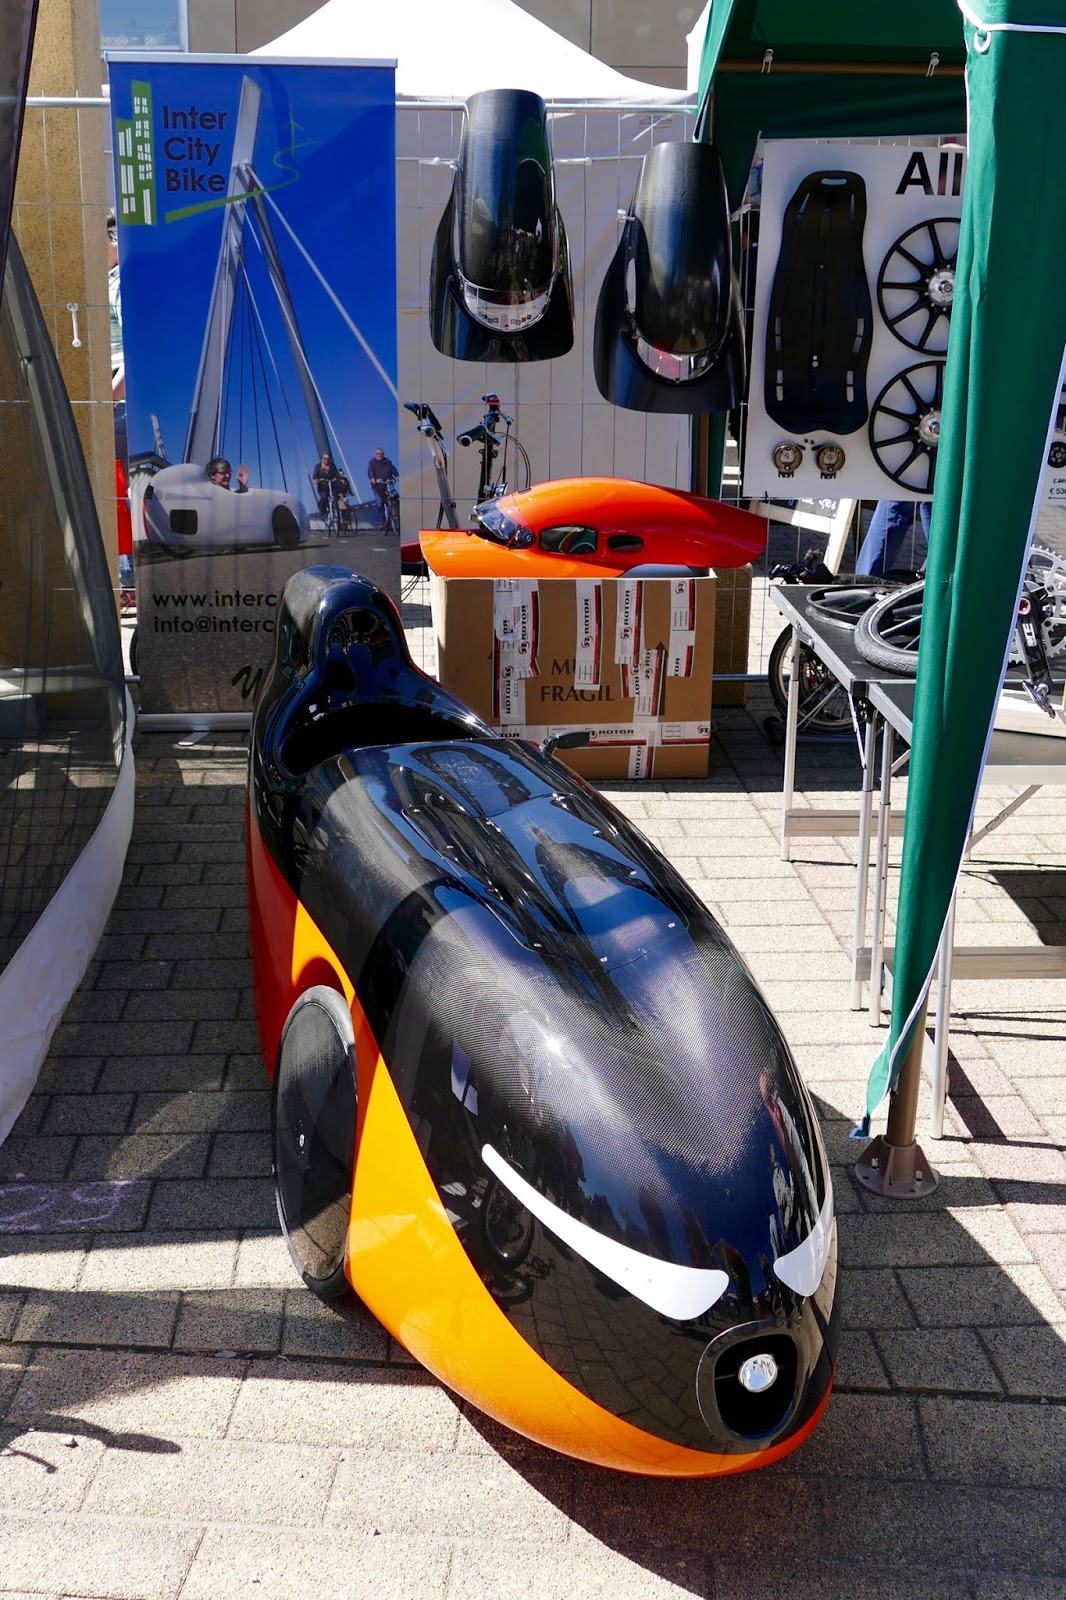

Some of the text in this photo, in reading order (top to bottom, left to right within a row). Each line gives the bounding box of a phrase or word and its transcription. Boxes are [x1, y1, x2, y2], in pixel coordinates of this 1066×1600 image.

[163, 105, 227, 130] Inter
[164, 136, 221, 167] City
[166, 167, 226, 192] Bike
[895, 151, 963, 196] All
[540, 685, 615, 702] FRAGIL
